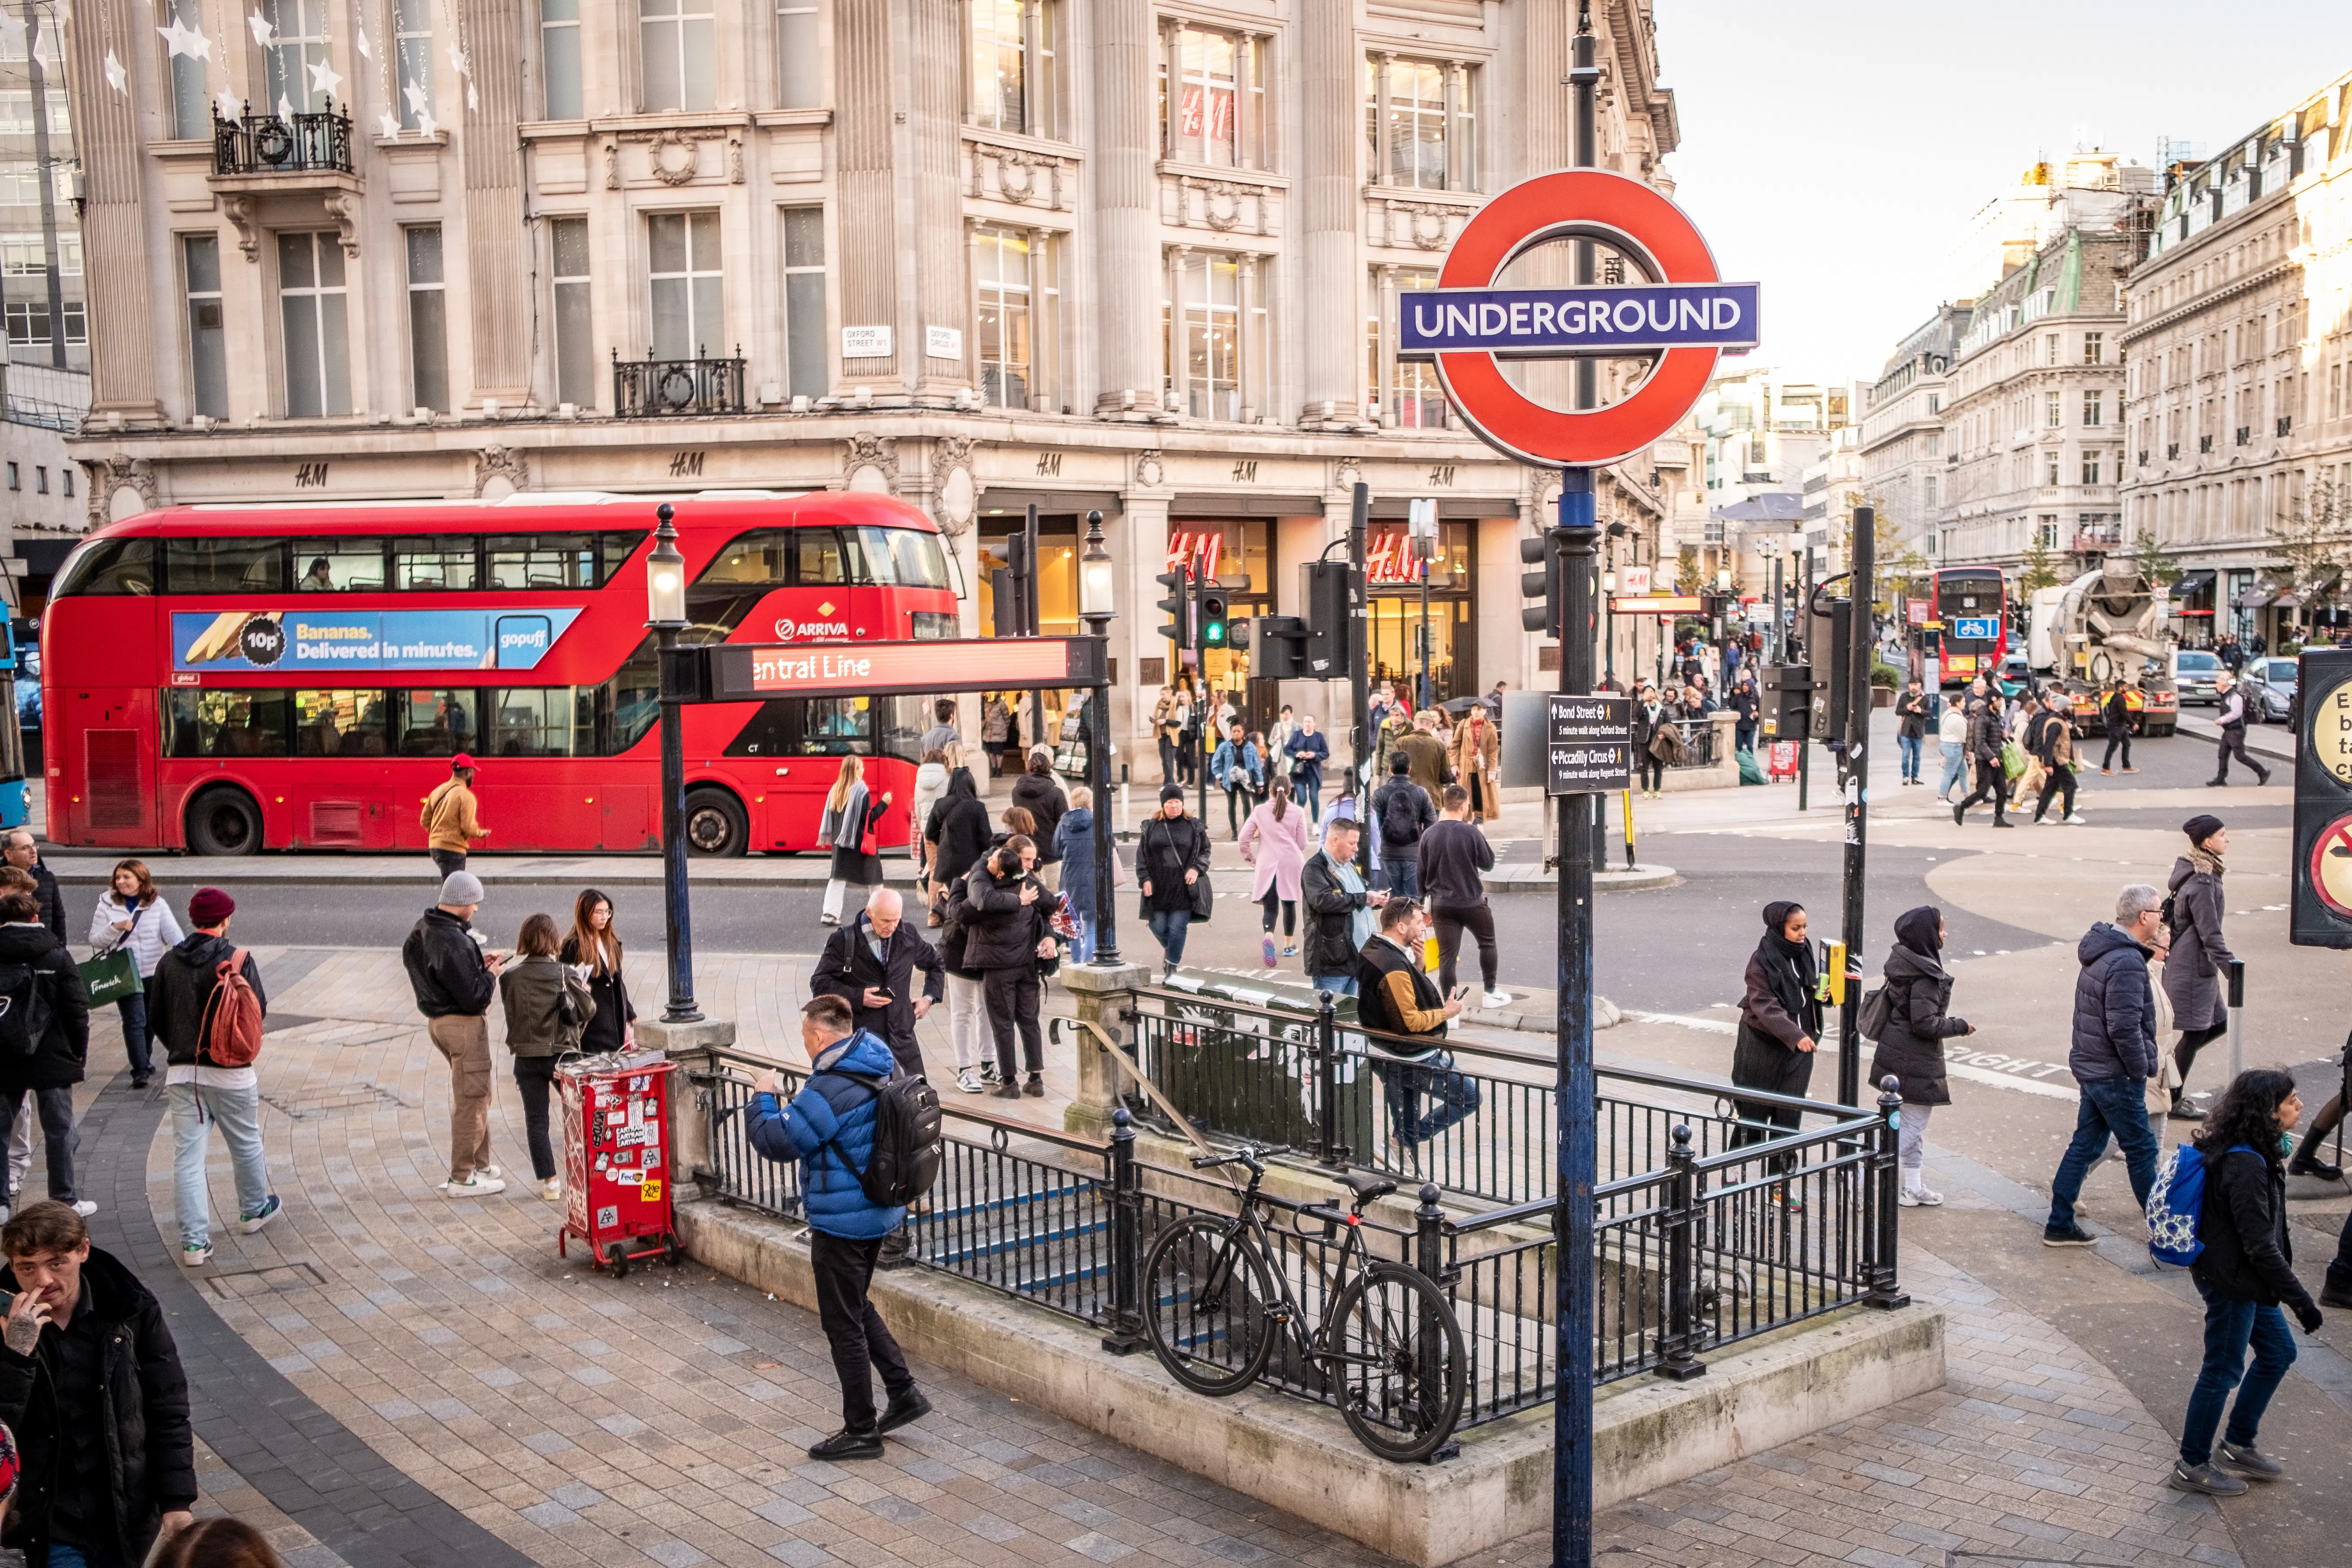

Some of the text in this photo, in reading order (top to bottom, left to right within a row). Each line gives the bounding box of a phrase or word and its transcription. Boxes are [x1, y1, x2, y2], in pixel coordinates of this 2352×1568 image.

[1415, 298, 1741, 337] UNDERGROUND
[847, 339, 873, 347] STREET
[669, 451, 705, 477] H&M
[1036, 453, 1062, 477] H&M
[1231, 461, 1258, 483] H&M
[295, 463, 328, 488] H&M
[1428, 466, 1455, 487] H&M
[1167, 532, 1222, 581] HM
[1366, 533, 1424, 582] H&M
[296, 623, 373, 640] Bananas.
[500, 630, 546, 648] gopuff
[796, 623, 848, 636] ARRIVA
[296, 640, 478, 659] Delivered in minutes.
[823, 655, 871, 678] Line
[1559, 705, 1596, 719] Bond Street
[1559, 725, 1627, 737] 5 minute walk along Oxford Street
[748, 744, 759, 752] CT
[1558, 750, 1608, 767] Piccadilly Circus
[1559, 768, 1627, 780] 9 minute walk along Regent Street
[91, 975, 121, 995] Fenwick
[621, 1172, 634, 1181] Fed
